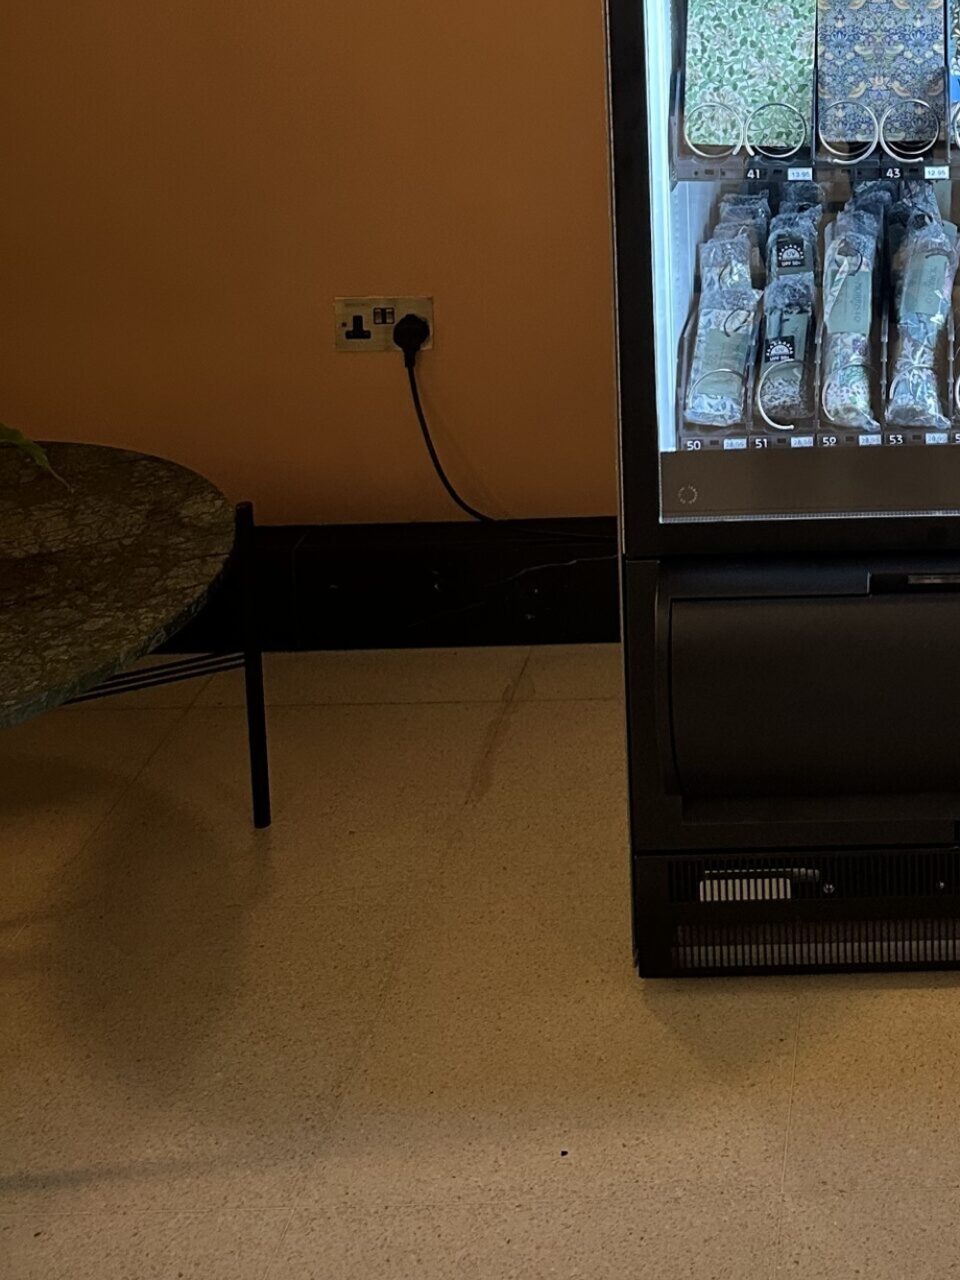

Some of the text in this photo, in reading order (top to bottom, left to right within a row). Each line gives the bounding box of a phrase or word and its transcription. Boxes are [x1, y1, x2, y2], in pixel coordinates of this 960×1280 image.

[746, 168, 760, 180] 41
[886, 167, 901, 178] 43
[754, 438, 768, 448] 51
[822, 436, 836, 446] 52
[889, 434, 903, 444] 53
[686, 440, 700, 450] 50
